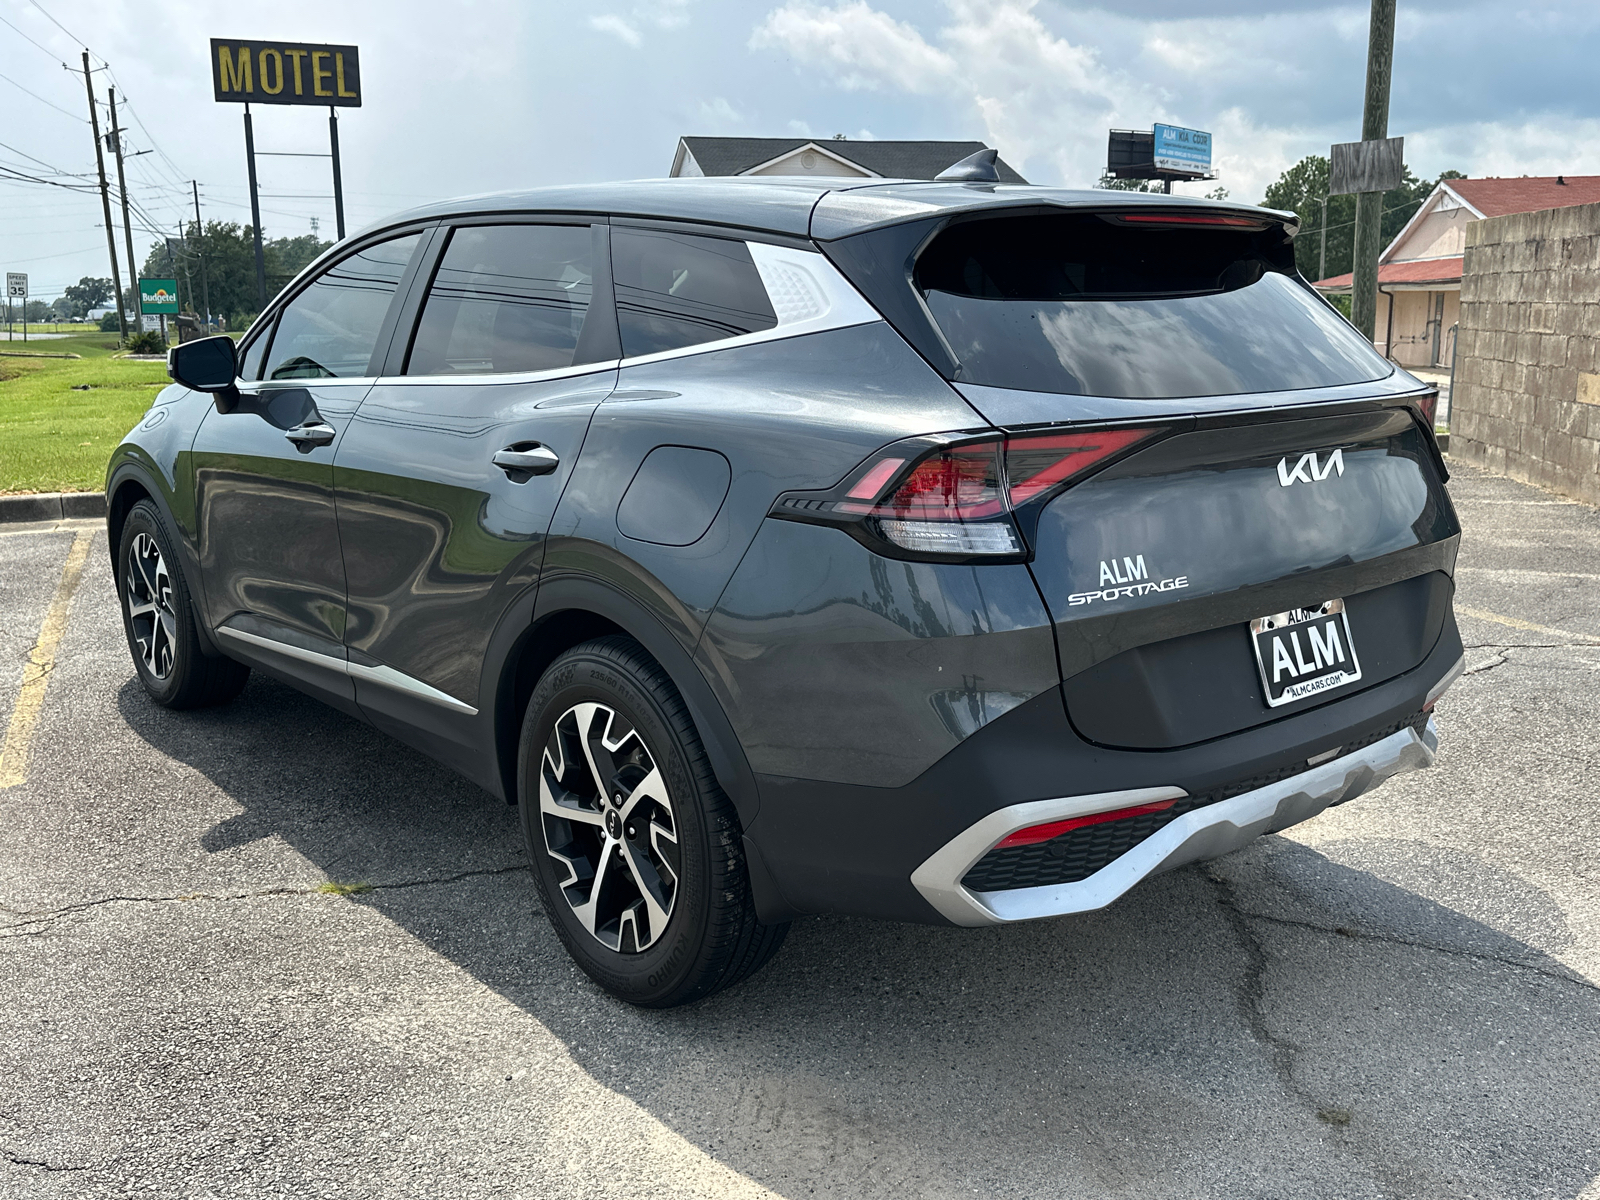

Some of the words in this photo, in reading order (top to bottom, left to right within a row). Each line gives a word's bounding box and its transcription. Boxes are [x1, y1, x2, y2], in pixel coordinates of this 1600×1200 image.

[218, 45, 357, 98] MOTEL
[1163, 129, 1176, 140] ALM
[1179, 131, 1189, 142] KIA
[10, 286, 25, 296] 35
[142, 293, 176, 304] Budgetel
[1277, 448, 1345, 487] KIA
[1100, 554, 1149, 587] ALM
[1067, 576, 1189, 606] SPORTAGE
[1287, 608, 1311, 625] ALM
[1273, 620, 1345, 683] ALM
[590, 669, 617, 688] 235/60
[618, 685, 635, 703] R18
[1291, 674, 1342, 698] ALMCARS.COM
[647, 932, 690, 988] KUMHO
